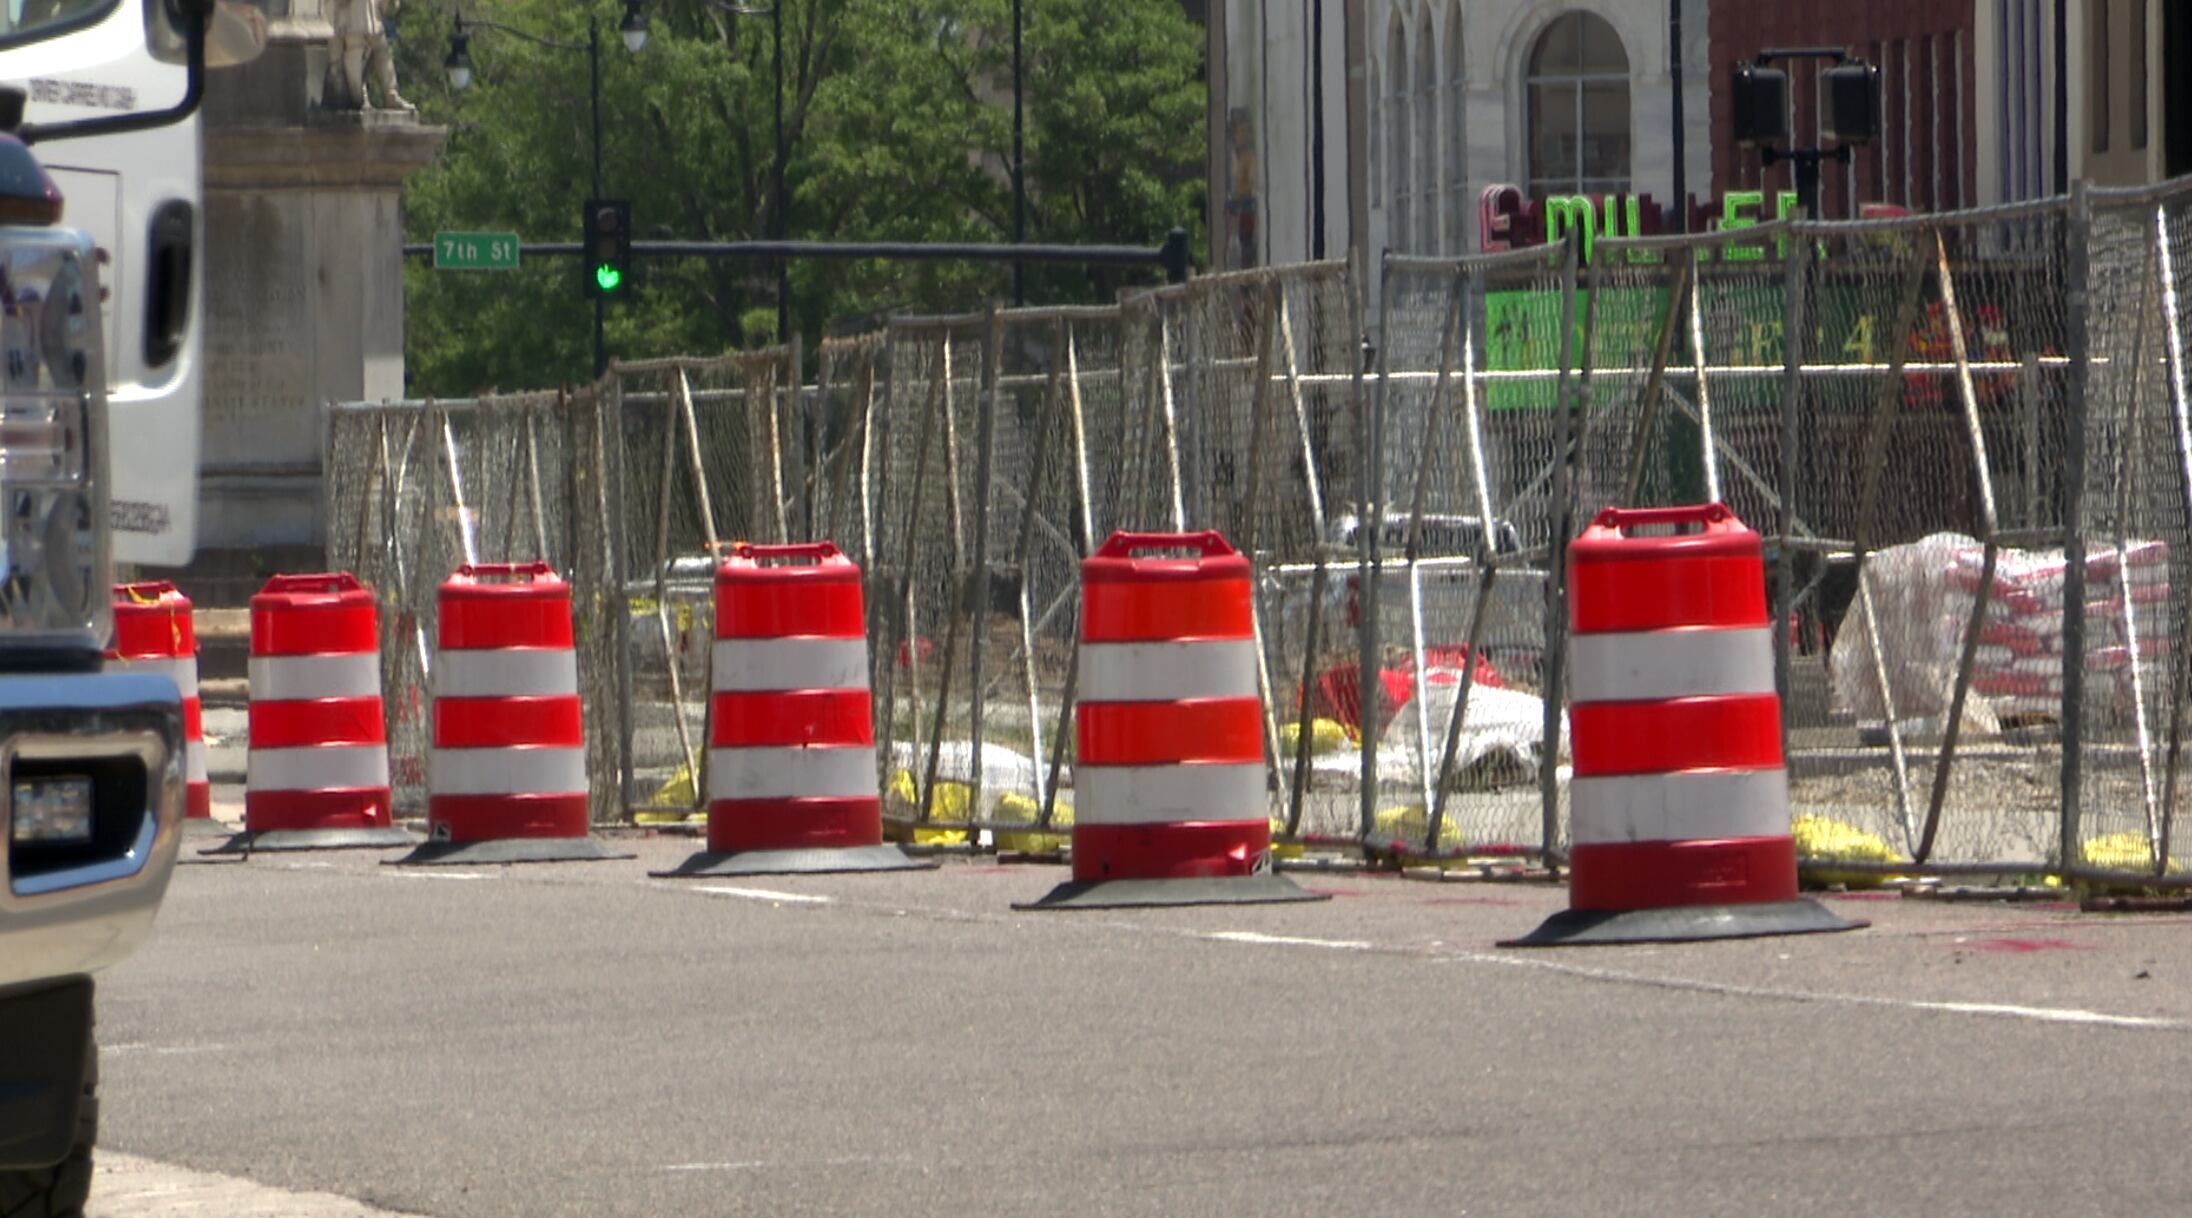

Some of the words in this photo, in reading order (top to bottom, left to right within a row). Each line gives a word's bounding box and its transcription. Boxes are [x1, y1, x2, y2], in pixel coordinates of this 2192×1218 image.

[443, 240, 478, 260] 7th
[491, 240, 512, 260] St
[1545, 191, 1827, 266] MILE
